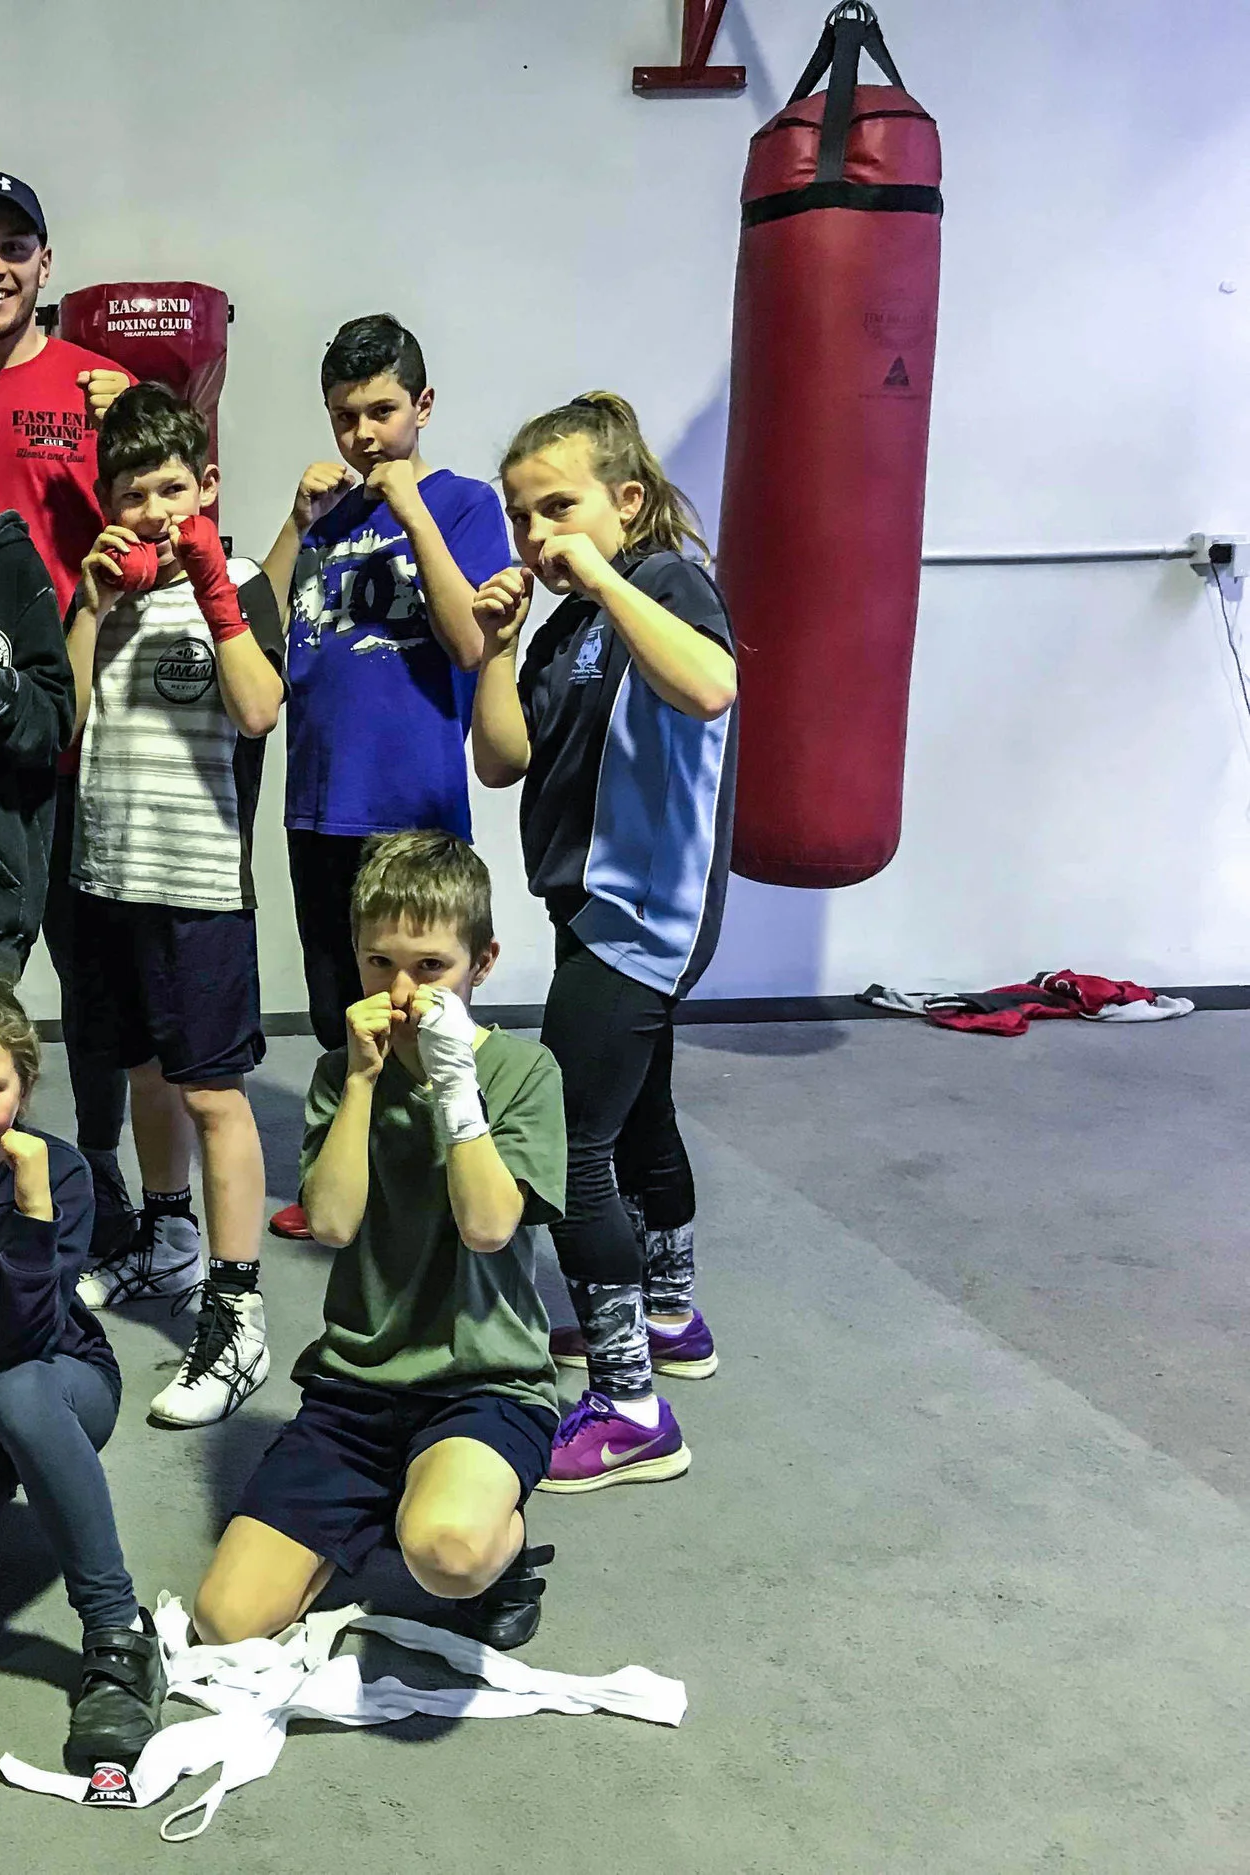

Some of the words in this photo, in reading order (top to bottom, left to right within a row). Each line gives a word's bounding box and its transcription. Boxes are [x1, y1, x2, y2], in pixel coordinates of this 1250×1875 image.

[108, 298, 153, 315] EAST
[156, 298, 191, 313] END
[107, 318, 157, 332] BOXING
[159, 317, 192, 330] CLUB
[12, 410, 56, 426] EAST
[24, 423, 83, 440] BOXING
[43, 438, 64, 446] CLUB
[90, 1790, 131, 1801] STING
